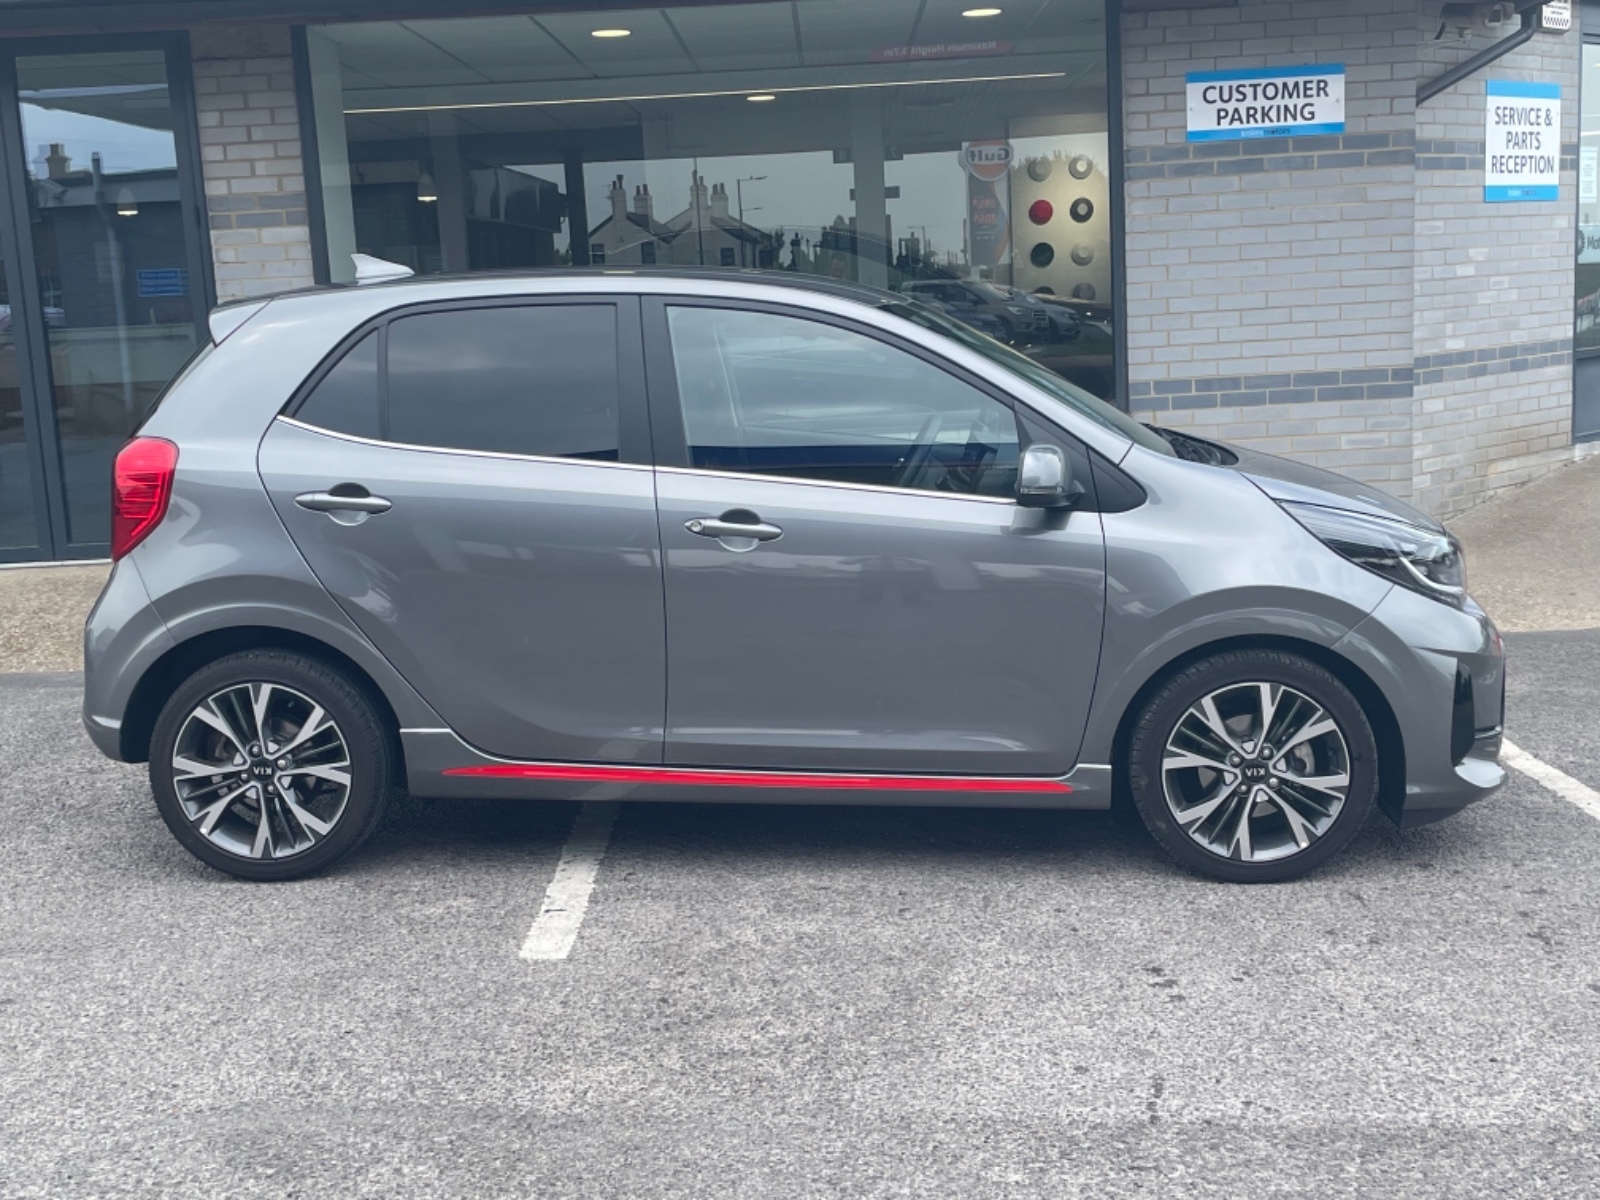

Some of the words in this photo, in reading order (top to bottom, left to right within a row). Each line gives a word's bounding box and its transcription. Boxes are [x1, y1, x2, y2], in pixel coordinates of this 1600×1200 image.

[1202, 79, 1329, 104] CUSTOMER
[1216, 102, 1315, 126] PARKING
[1494, 105, 1542, 126] SERVICE
[1544, 108, 1553, 127] &
[1505, 131, 1541, 150] PARTS
[1491, 155, 1555, 174] RECEPTION
[253, 766, 272, 776] KIA
[1245, 767, 1265, 777] KIA
